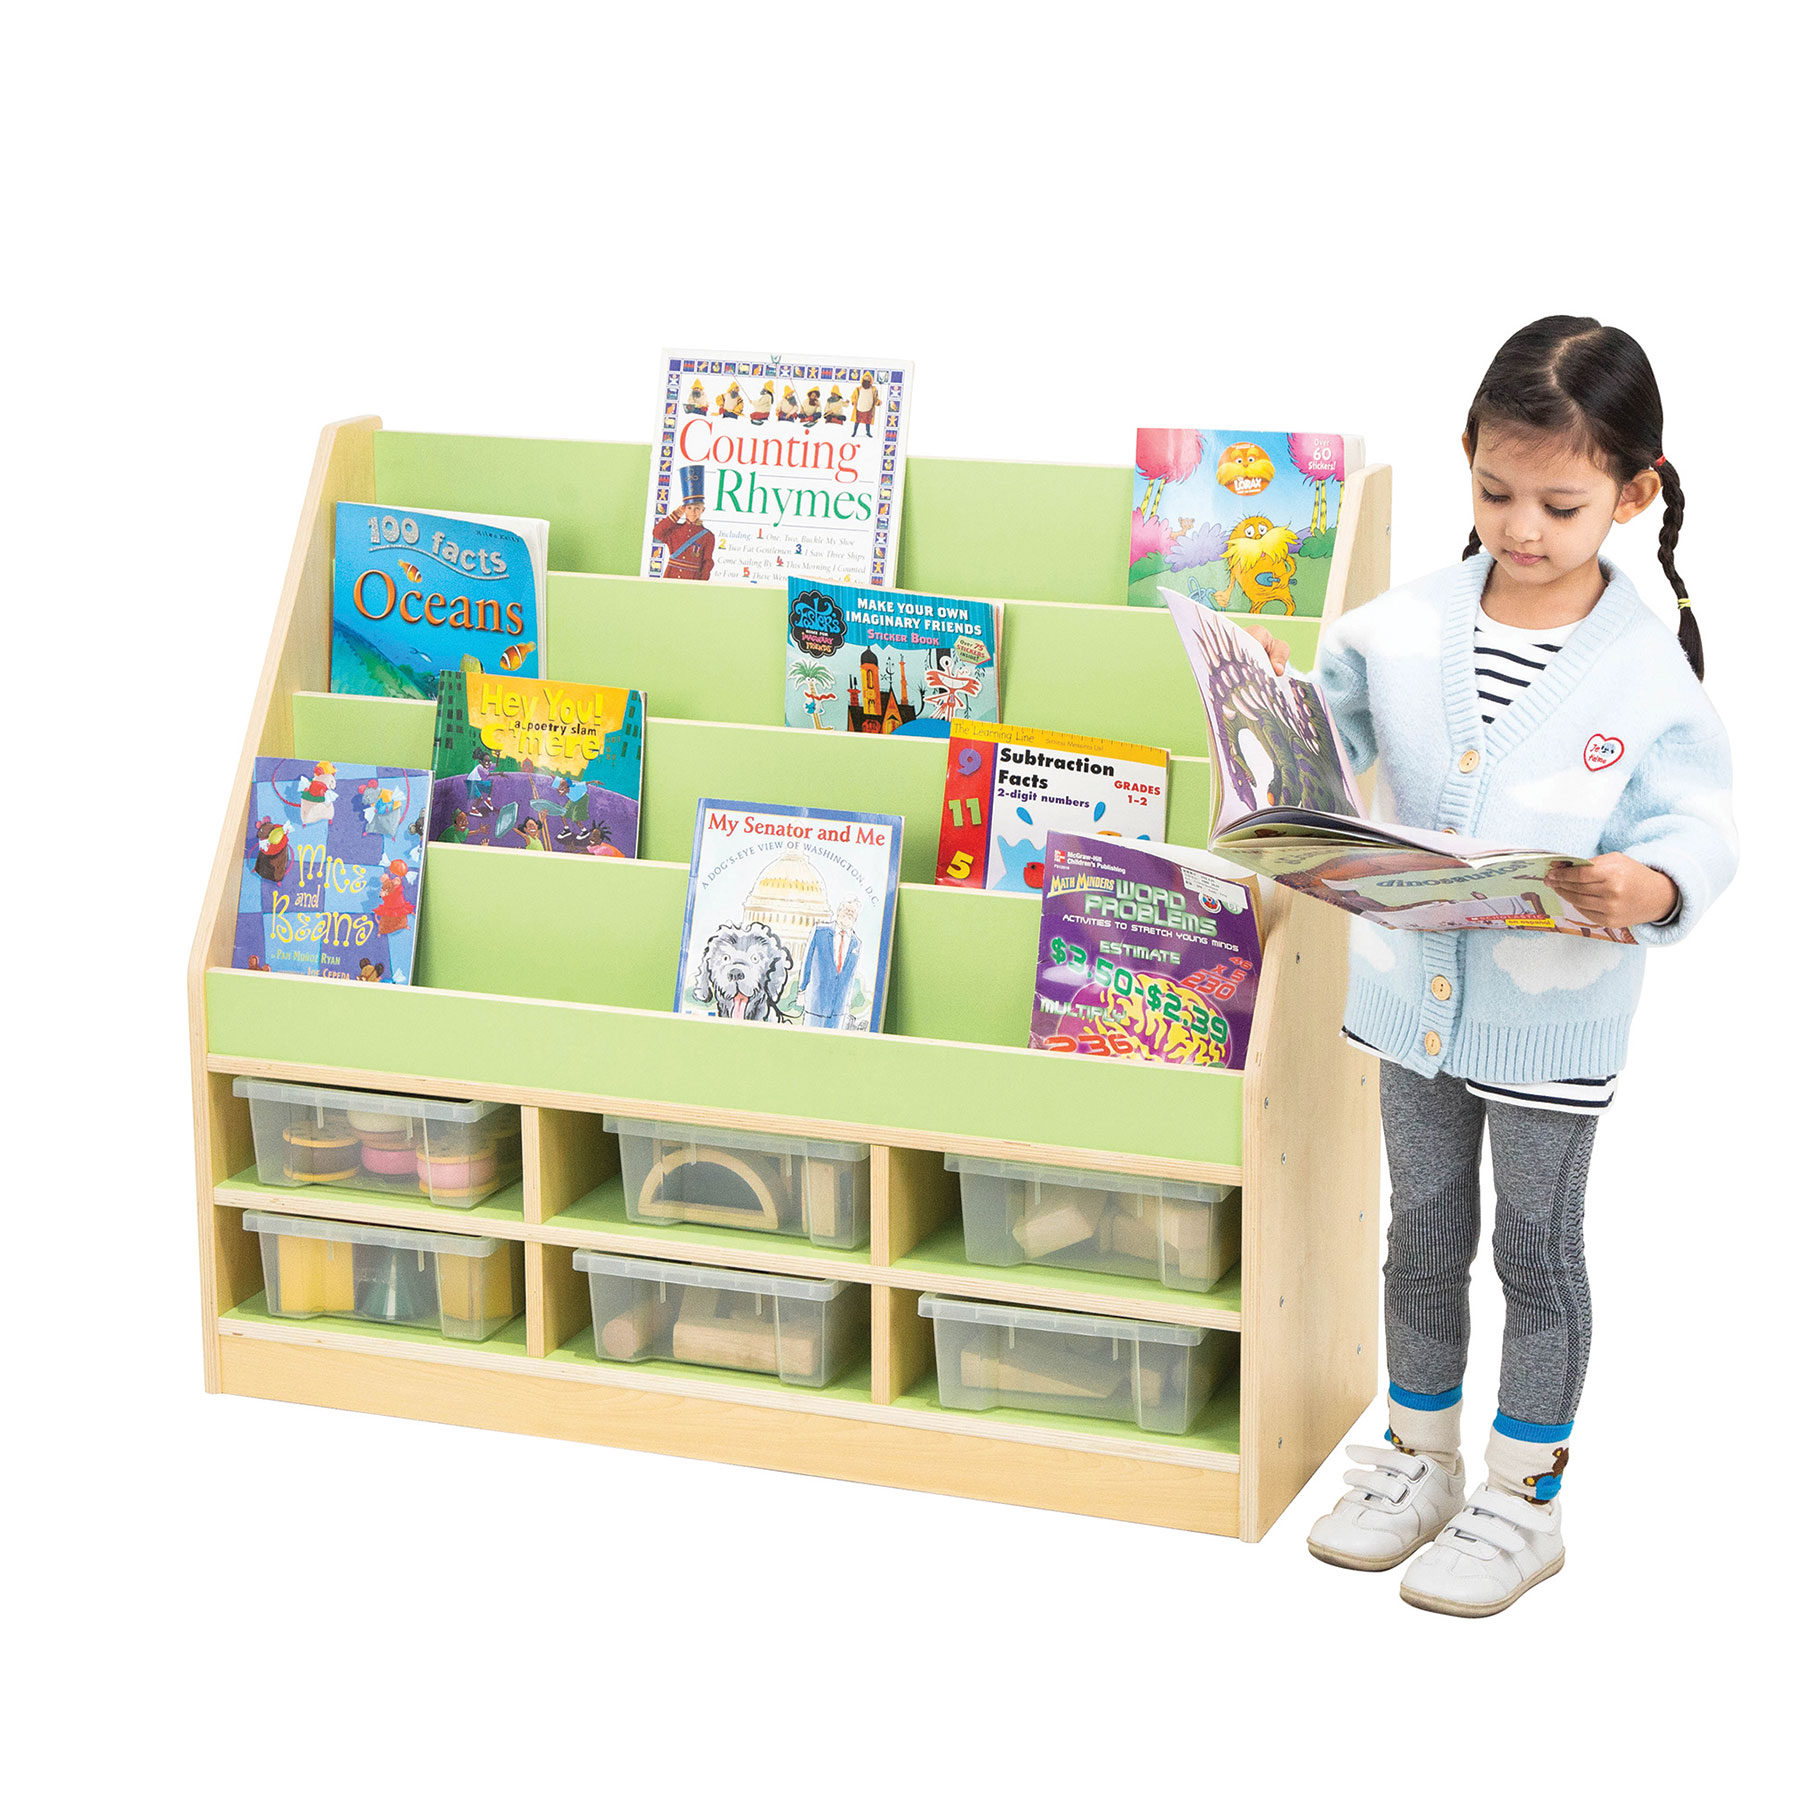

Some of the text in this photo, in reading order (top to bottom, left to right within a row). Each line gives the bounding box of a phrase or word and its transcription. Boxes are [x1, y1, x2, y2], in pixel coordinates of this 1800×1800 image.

[680, 418, 860, 483] Counting
[1314, 438, 1329, 446] Over
[1313, 447, 1332, 461] 60
[1308, 461, 1336, 470] Stickers!
[1234, 478, 1262, 491] LORAX
[713, 469, 871, 527] Rhymes
[367, 515, 508, 575] 100 facts
[757, 528, 764, 540] 1
[718, 539, 726, 550] 2
[756, 546, 792, 556] Gentlemen
[794, 544, 802, 555] 3
[742, 567, 750, 578] 5
[776, 556, 784, 567] 4
[837, 565, 866, 574] Counted
[353, 569, 525, 635] Oceans
[857, 598, 969, 621] MAKE YOUR OWN
[846, 610, 983, 636] IMAGINARY FRIENDS
[867, 629, 908, 643] STICKER
[974, 643, 984, 651] 75
[957, 644, 985, 658] STICKERS
[481, 683, 603, 728] Hey You!
[515, 720, 597, 736] a poetry slam
[954, 723, 1035, 743] The Learning Line
[480, 722, 600, 760] C'mere
[957, 748, 982, 776] 9
[1000, 748, 1115, 777] Subtraction
[998, 770, 1048, 790] Facts
[1114, 780, 1161, 796] GRADES
[997, 788, 1090, 808] 2-digit numbers
[948, 797, 982, 827] 11
[708, 813, 885, 846] My Senator and Me
[702, 841, 880, 907] A DOG'S-EYE VIEW OF WASHINGTON, D.C.
[946, 850, 974, 879] 5
[1067, 859, 1096, 868] Children's
[1097, 863, 1126, 875] Publishing
[1076, 872, 1115, 892] MINDERS
[295, 885, 319, 908] and
[1115, 878, 1187, 911] WORD
[1085, 893, 1218, 937] PROBLEMS
[1062, 914, 1240, 952] ACTIVITIES TO STRETCH YOUNG MINDS
[1099, 940, 1181, 964] ESTIMATE
[1228, 956, 1253, 970] 46
[1179, 971, 1236, 1000] 230
[1231, 969, 1247, 983] 5
[1040, 998, 1127, 1023] MULTIPLY
[1044, 1034, 1134, 1056] 236
